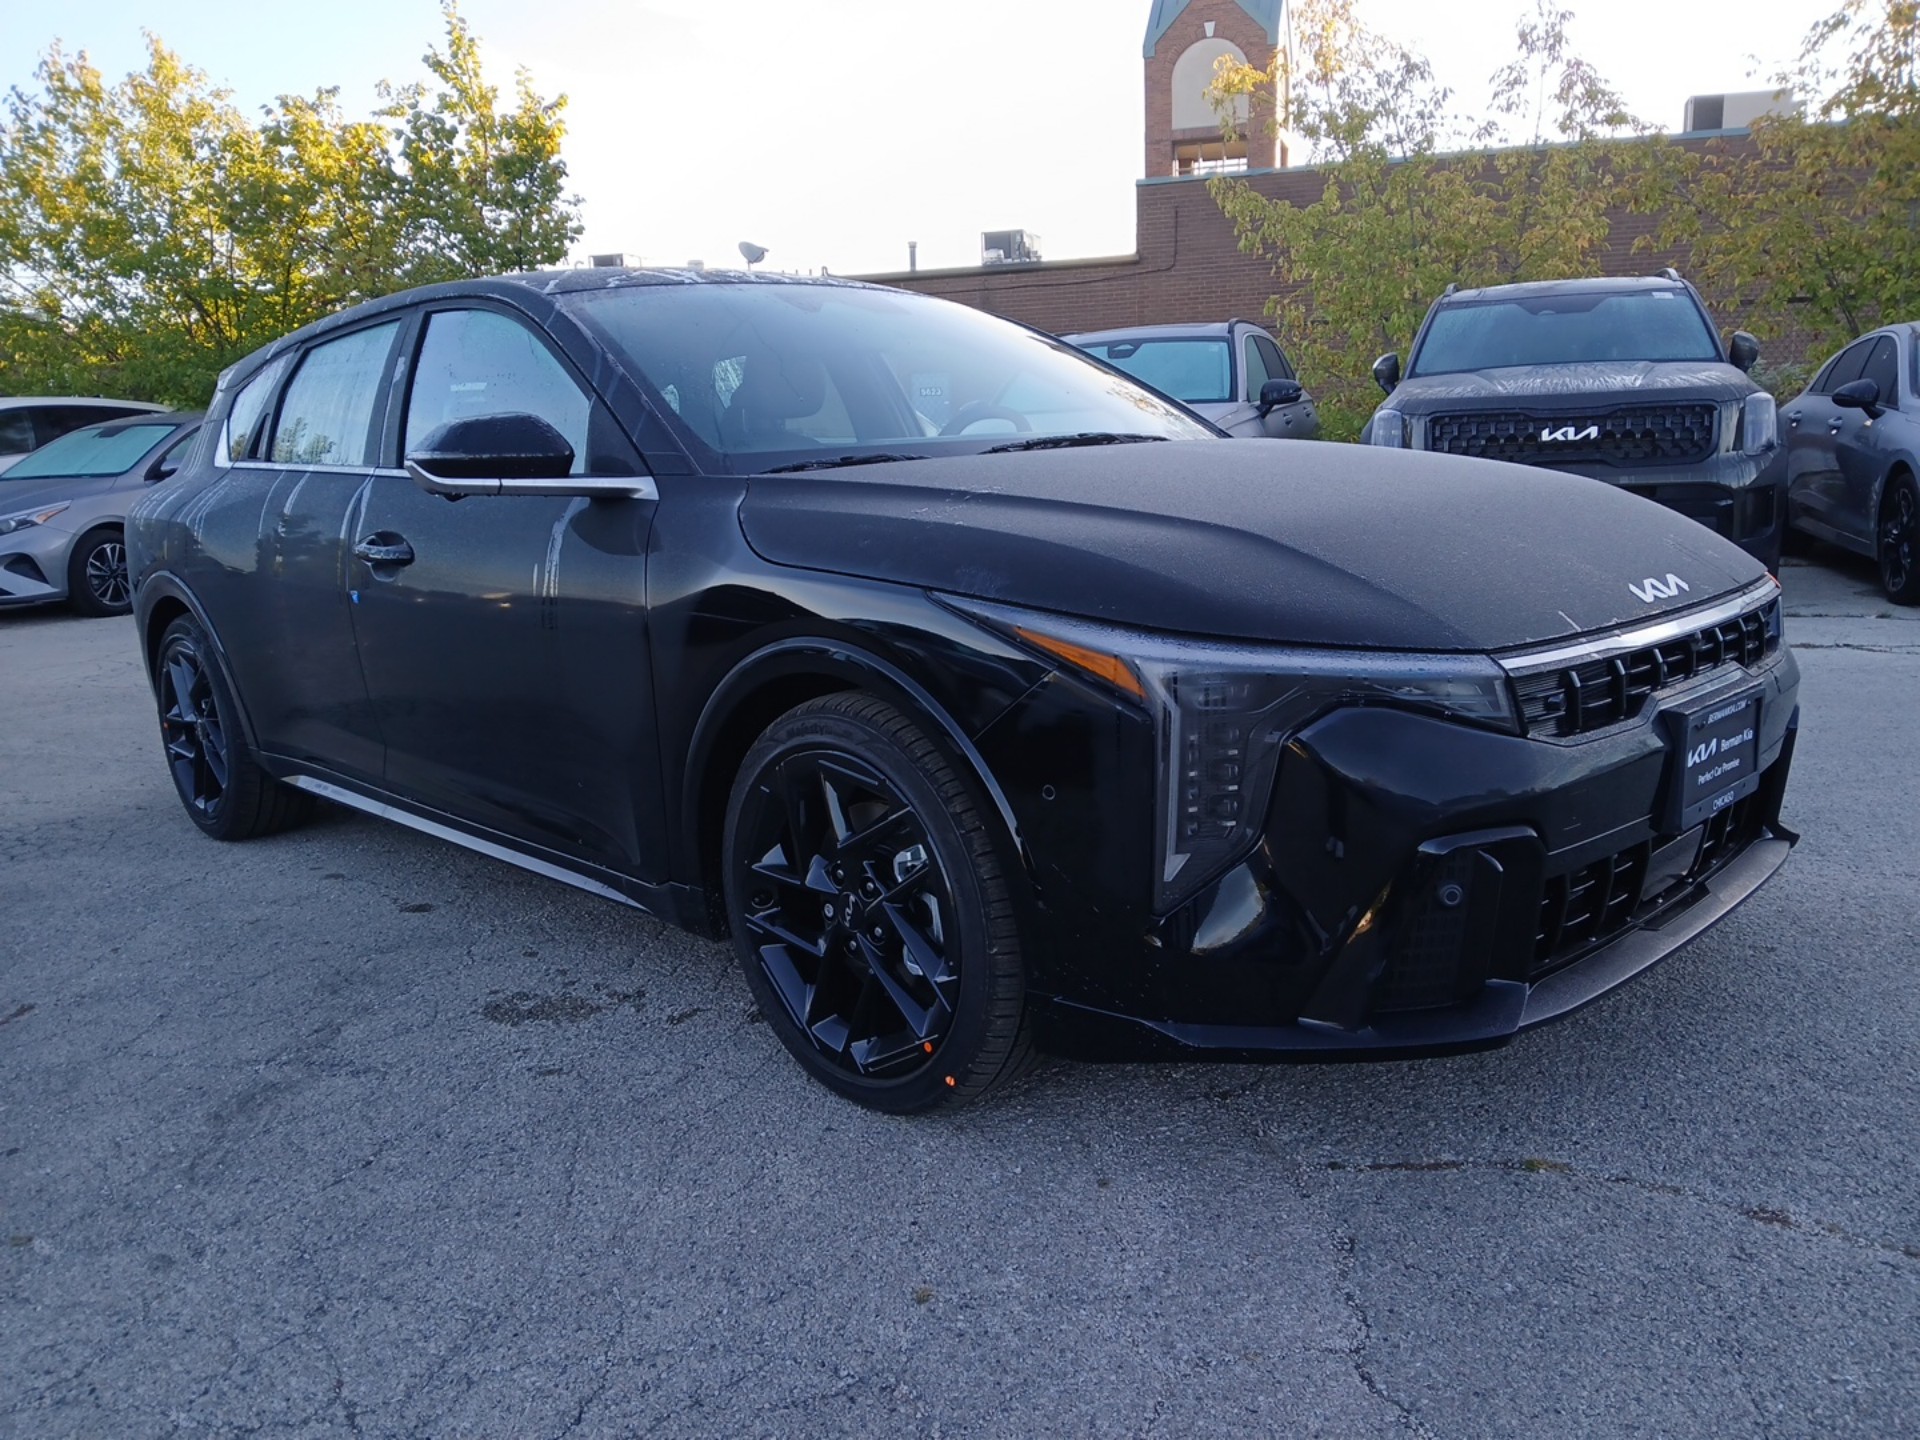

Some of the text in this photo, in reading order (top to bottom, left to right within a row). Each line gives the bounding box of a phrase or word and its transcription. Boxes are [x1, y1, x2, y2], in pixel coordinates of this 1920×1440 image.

[1541, 426, 1599, 441] KIA
[1628, 573, 1690, 604] KIA
[1721, 728, 1753, 752] Berman Kia
[1688, 738, 1717, 768] KIA
[1698, 759, 1740, 785] Perfect Car Promise
[1712, 791, 1734, 810] CHICAGO
